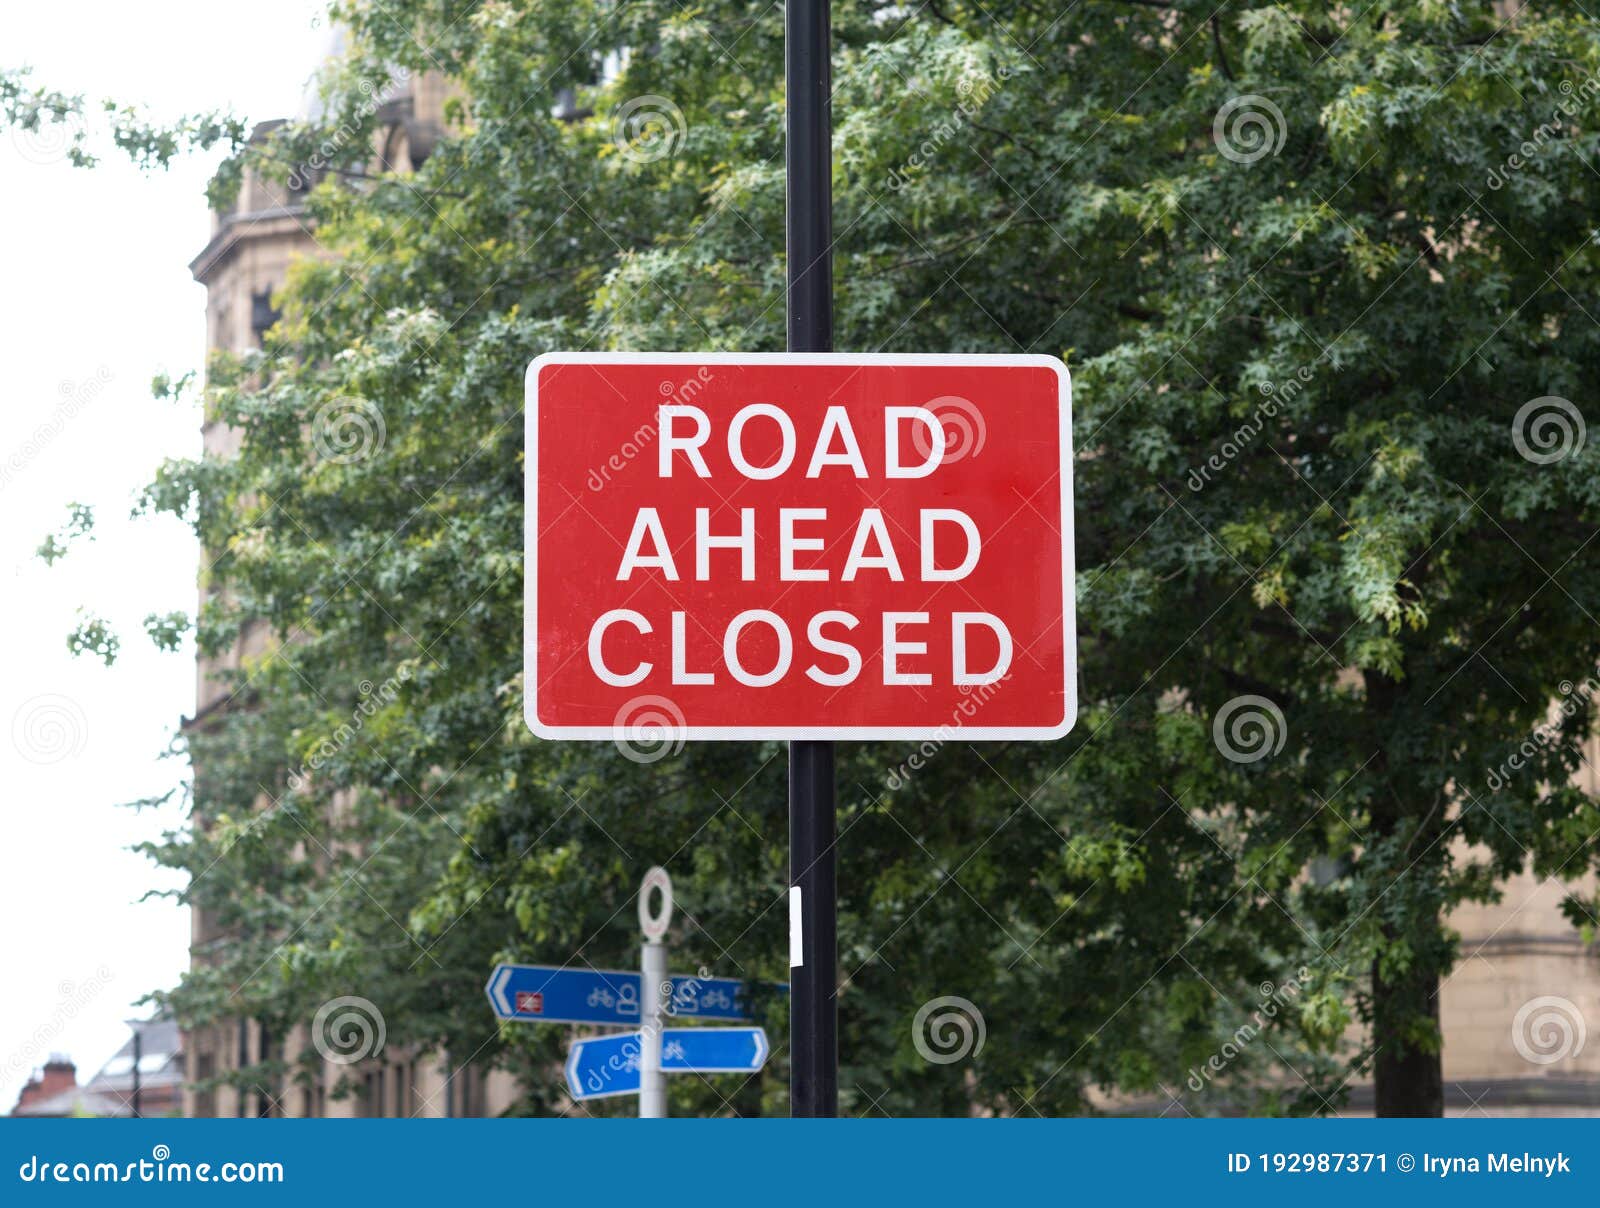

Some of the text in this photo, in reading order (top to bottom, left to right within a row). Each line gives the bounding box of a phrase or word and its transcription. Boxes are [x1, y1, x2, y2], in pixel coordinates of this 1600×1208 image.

[658, 404, 946, 479] ROAD
[616, 508, 982, 582] AHEAD
[588, 609, 1013, 687] CLOSED
